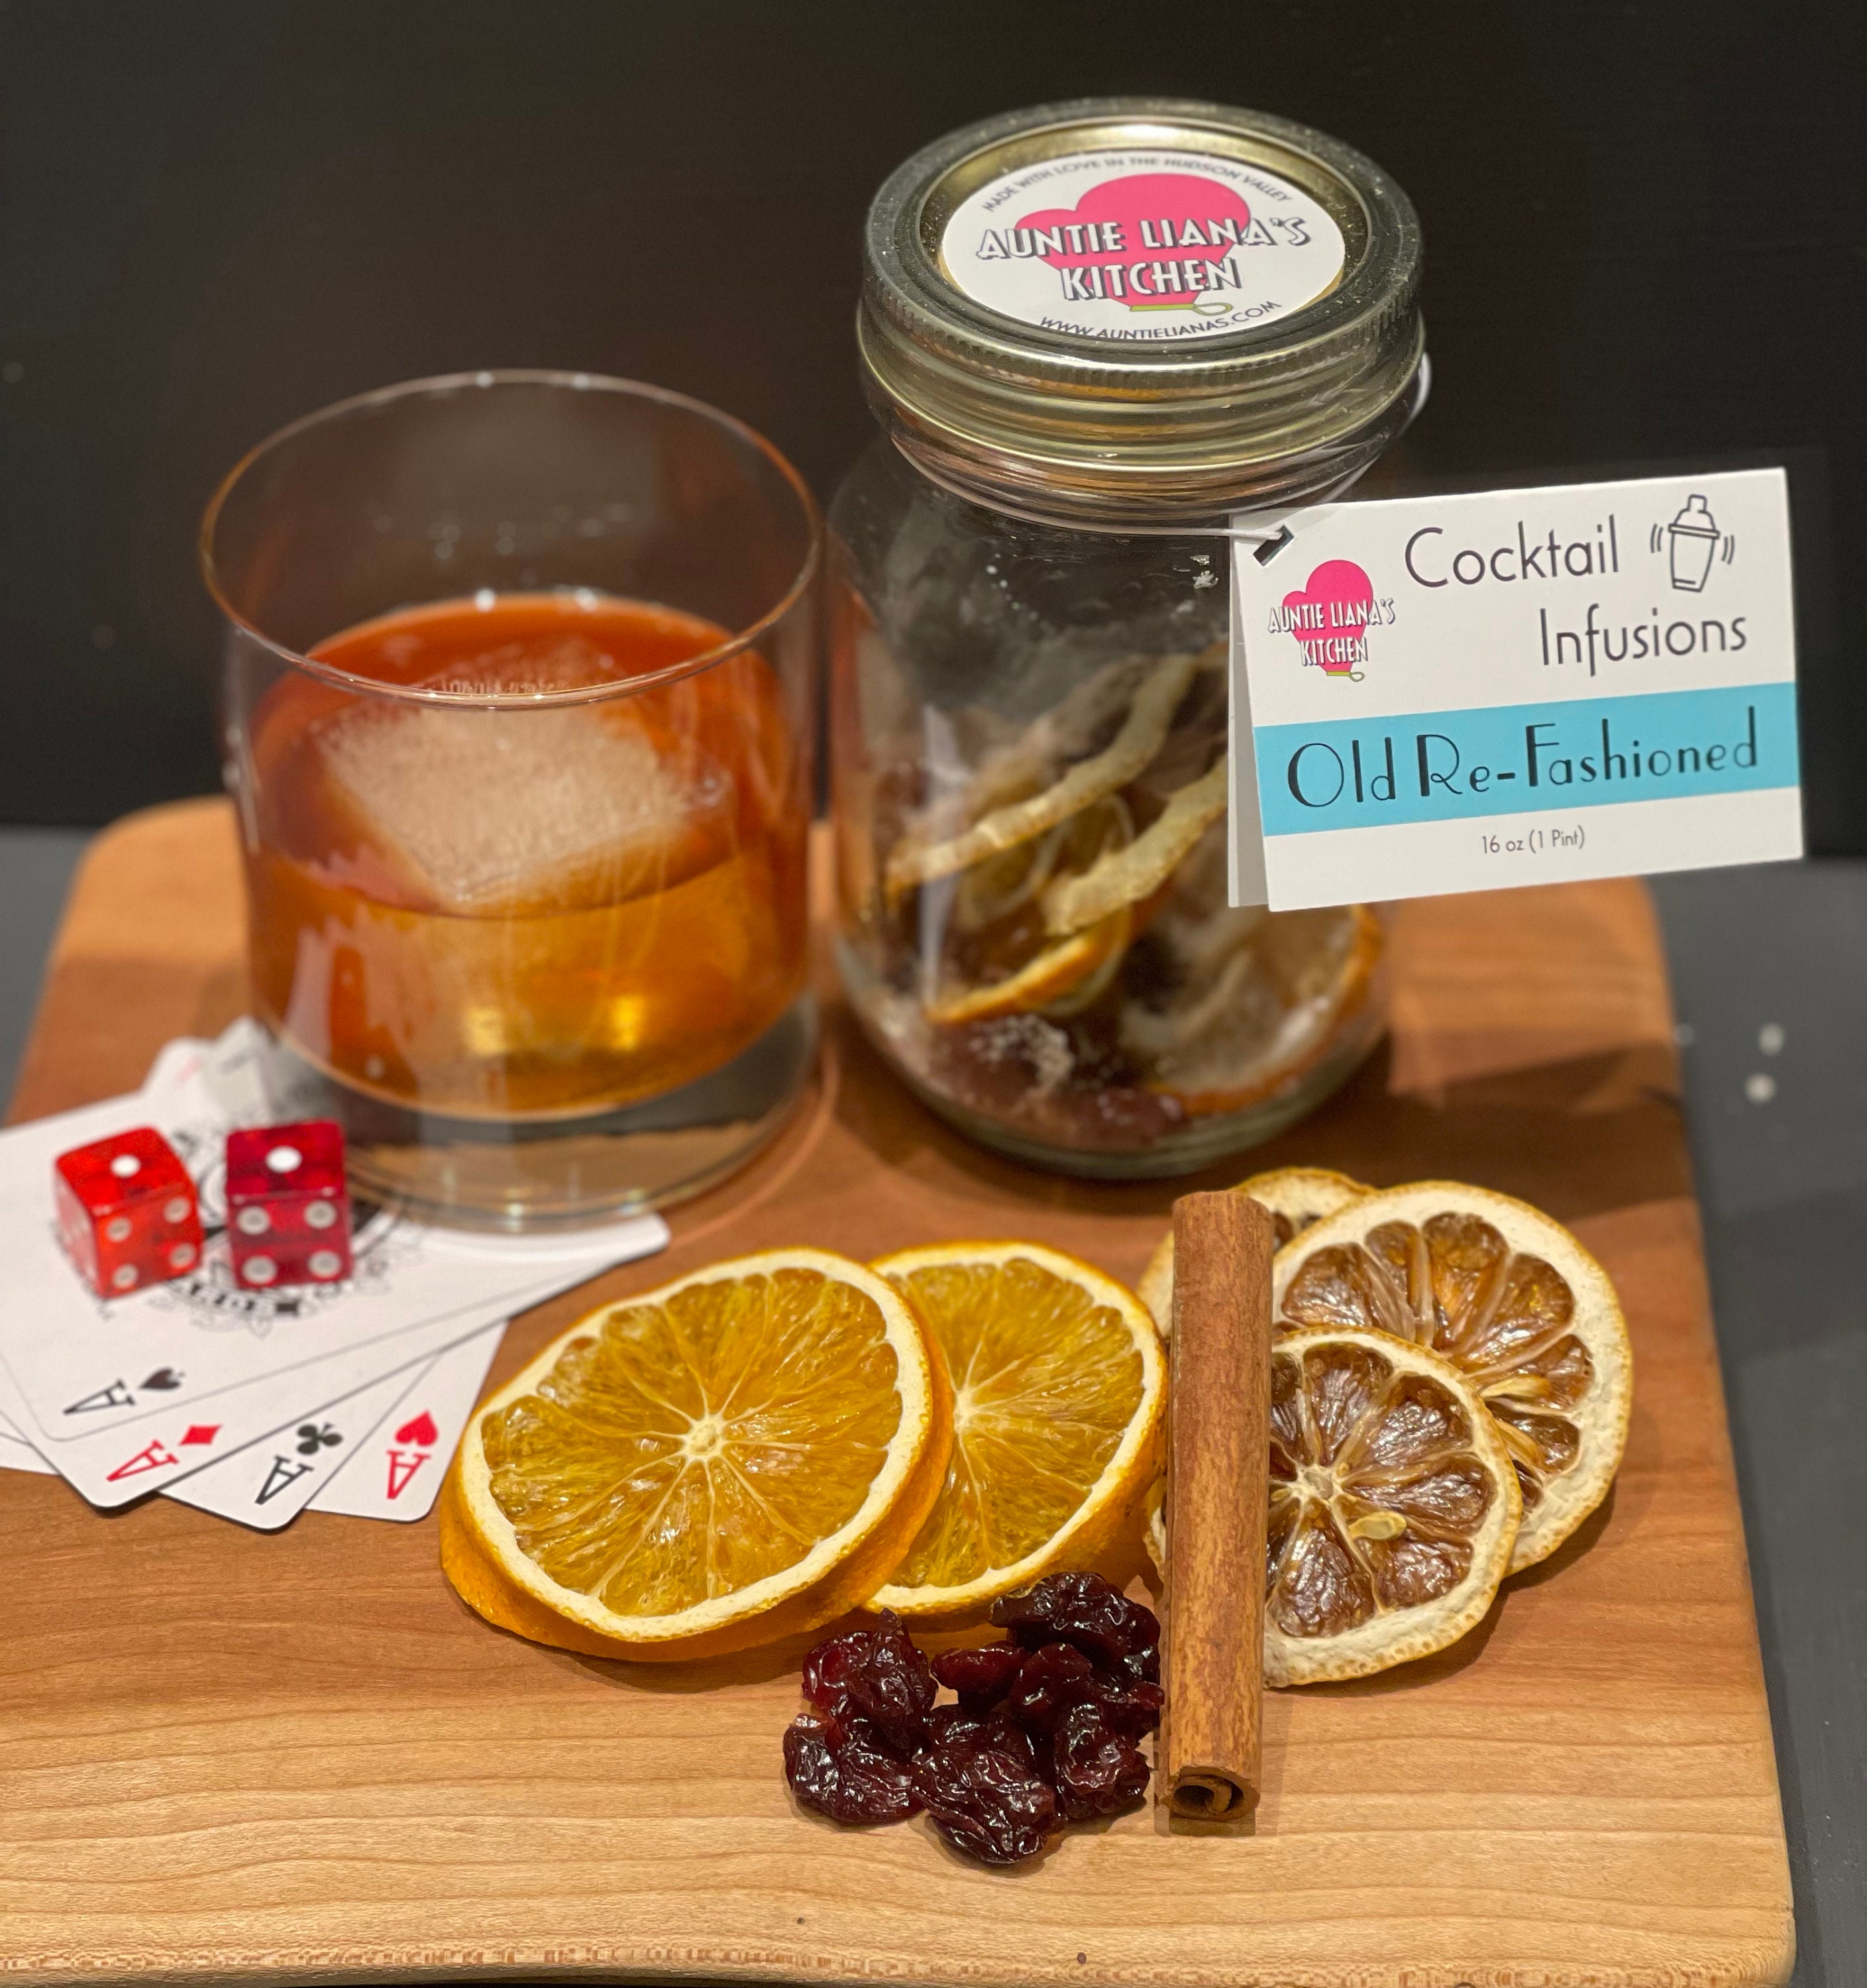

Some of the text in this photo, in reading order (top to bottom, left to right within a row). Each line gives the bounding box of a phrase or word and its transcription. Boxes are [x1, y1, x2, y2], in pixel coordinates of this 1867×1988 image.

[981, 156, 1293, 211] MADE WITH LOVE IN THE HUDSON VALLEY
[976, 216, 1312, 260] AUNTIE LIANA'S
[1061, 256, 1242, 301] KITCHEN
[1040, 300, 1282, 340] WWW.AUNTIELIANAS.COM
[1403, 513, 1620, 588] Cocktail
[1268, 597, 1396, 634] AUNTIE LIANA'S
[1299, 636, 1369, 667] KITCHEN
[1539, 604, 1748, 677] Infusions
[1286, 705, 1759, 808] Old Re-Fashioned
[1481, 824, 1585, 854] 16 oz (1 Pint)
[63, 1378, 136, 1416] A
[106, 1439, 180, 1482] A
[254, 1455, 314, 1506] A
[386, 1449, 431, 1500] A
